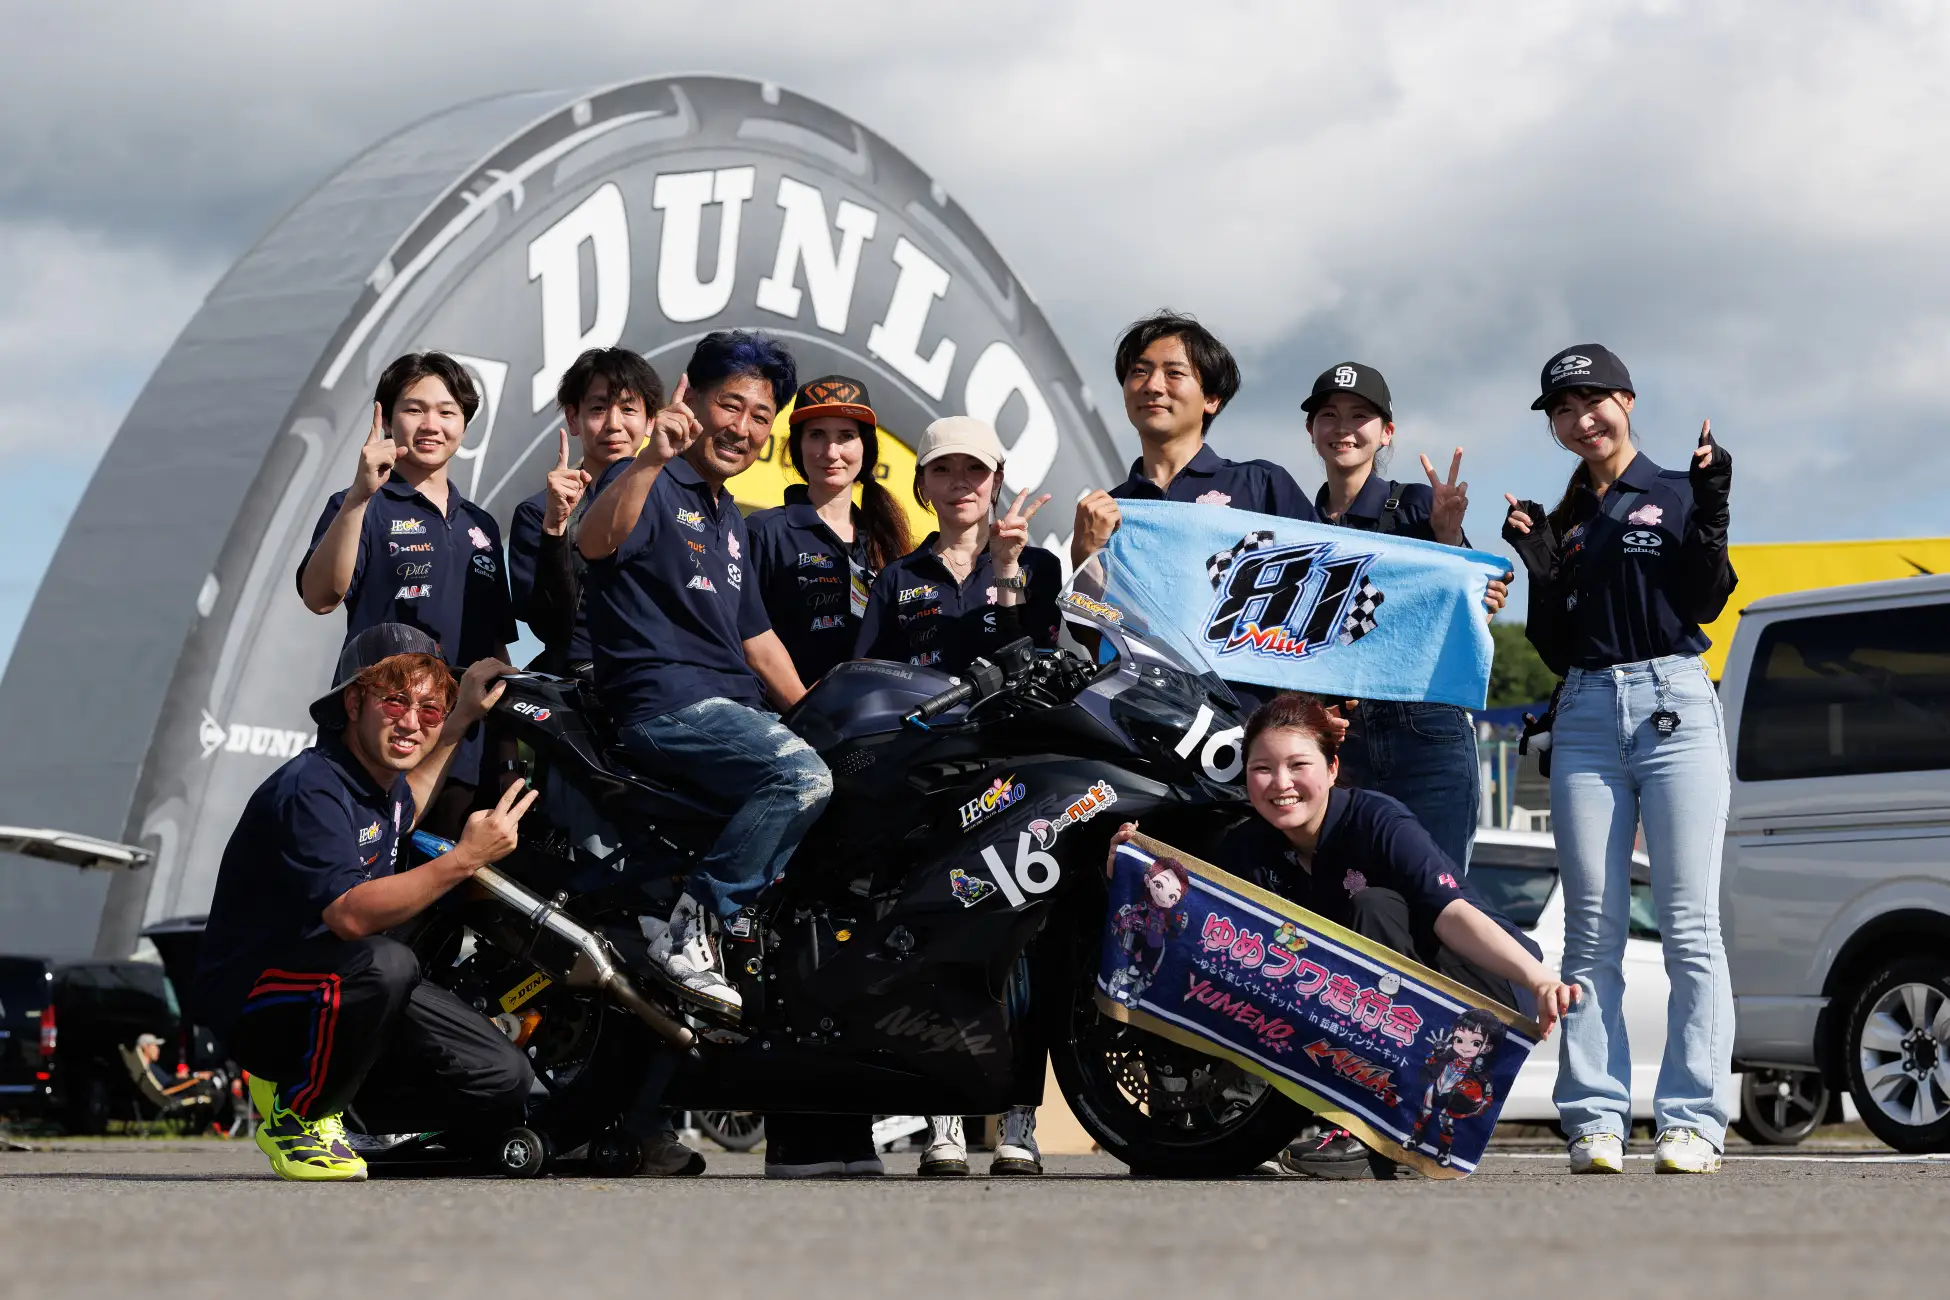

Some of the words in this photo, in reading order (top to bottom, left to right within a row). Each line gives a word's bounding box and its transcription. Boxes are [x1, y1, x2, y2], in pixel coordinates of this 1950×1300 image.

[528, 165, 1091, 575] DUNLO
[1206, 543, 1379, 645] 81
[848, 663, 914, 680] Kawasaki
[223, 723, 318, 758] DUNL
[1173, 703, 1245, 783] 16
[980, 831, 1062, 908] 16
[517, 973, 550, 999] DUN
[1184, 972, 1296, 1040] YUMENO
[874, 1005, 997, 1055] Ninja
